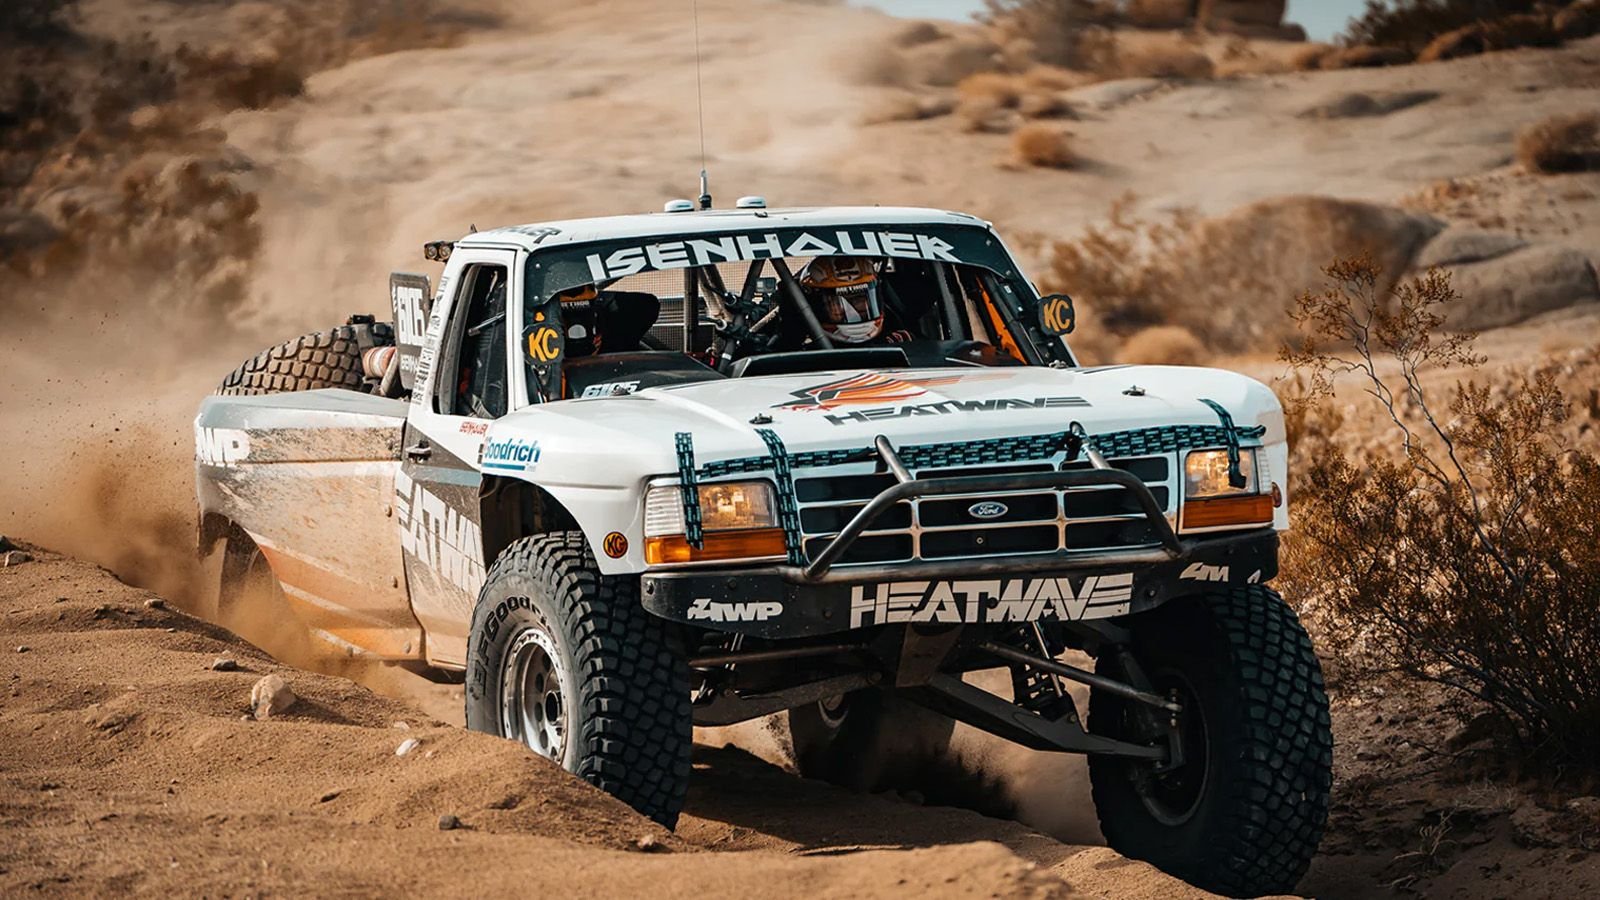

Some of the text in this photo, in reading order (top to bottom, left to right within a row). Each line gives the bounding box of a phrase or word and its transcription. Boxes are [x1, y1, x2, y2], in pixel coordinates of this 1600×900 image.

[586, 231, 962, 281] ISENHAUER
[1043, 298, 1071, 332] KC
[528, 327, 560, 362] KC
[824, 396, 1093, 426] HEATWAVE
[977, 503, 1000, 515] Ford
[850, 572, 1134, 629] HEATWAVE
